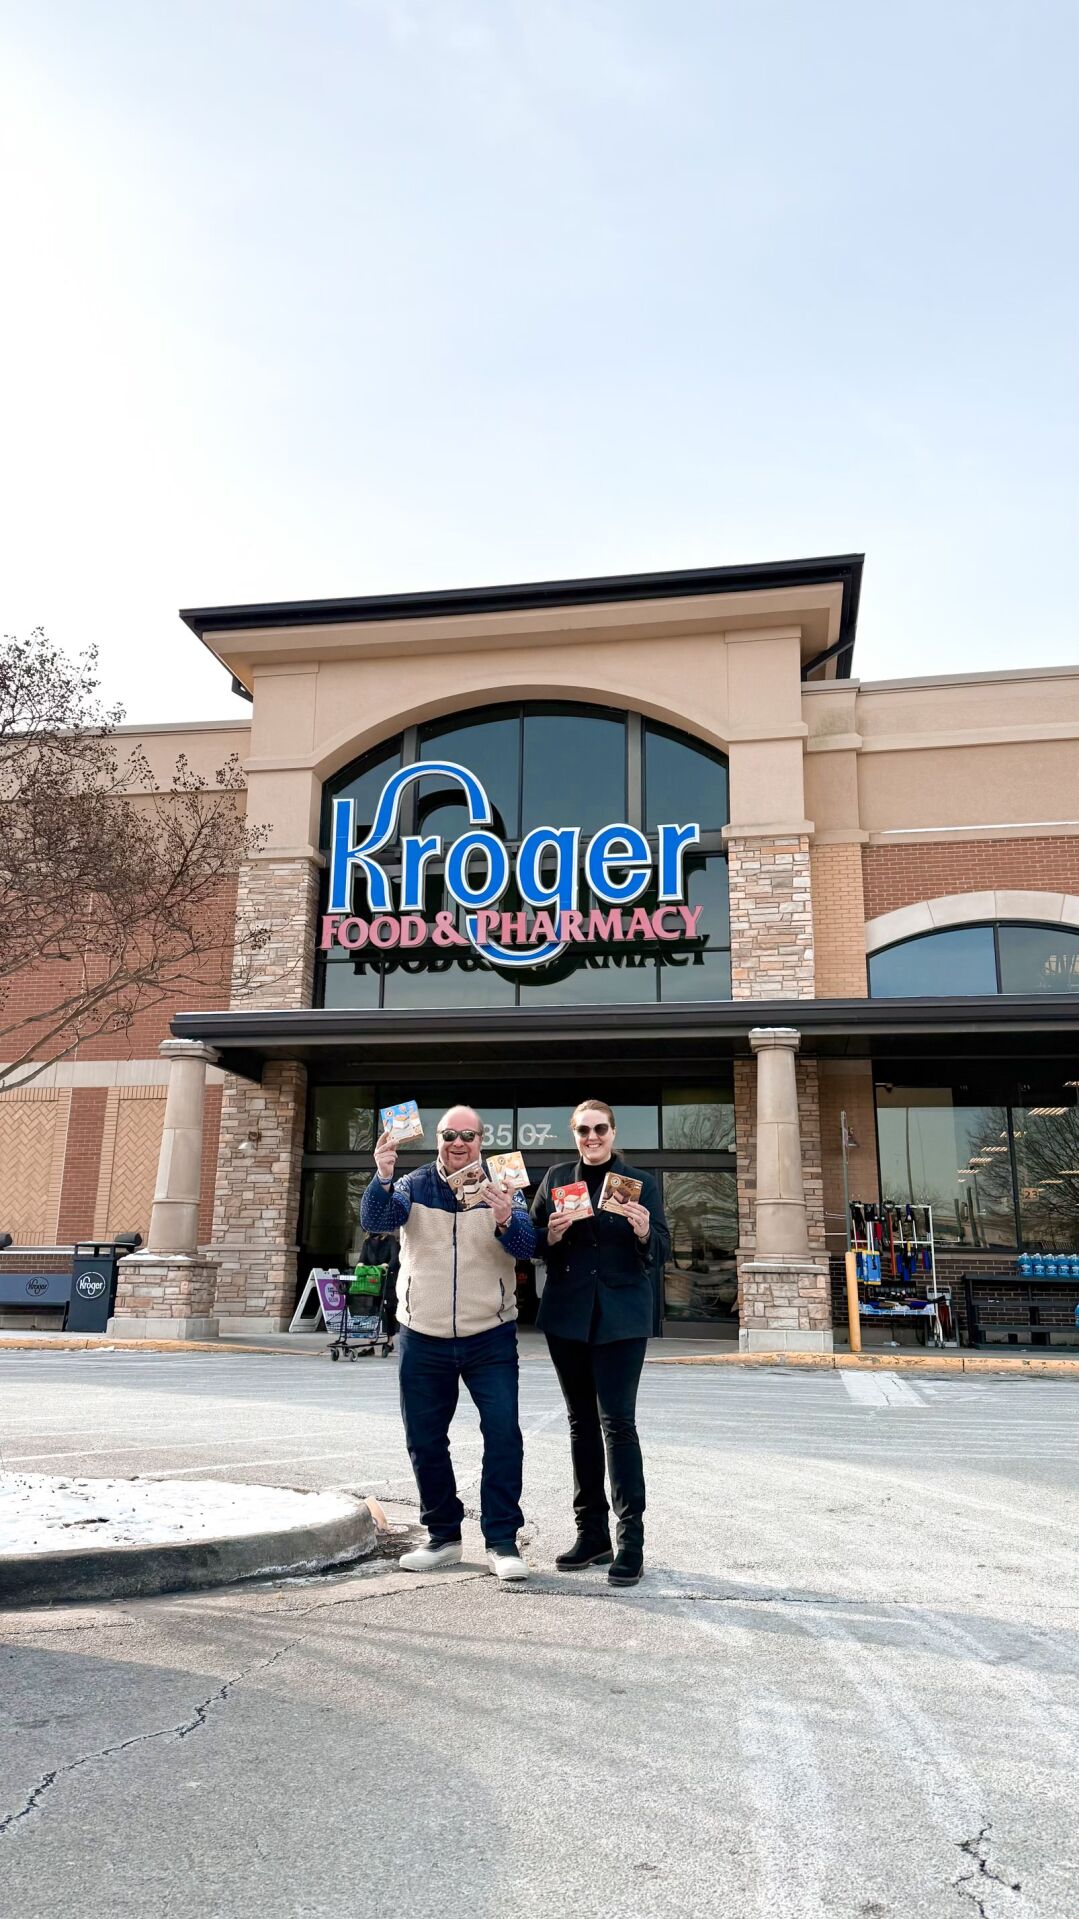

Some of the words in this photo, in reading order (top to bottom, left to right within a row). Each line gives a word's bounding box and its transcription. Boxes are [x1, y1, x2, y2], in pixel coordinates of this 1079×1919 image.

[327, 760, 701, 967] Kroger
[320, 913, 428, 951] FOOD
[431, 910, 472, 947] &
[476, 904, 704, 945] PHARMACY
[27, 1278, 48, 1295] Kroger
[79, 1275, 103, 1296] Kroger
